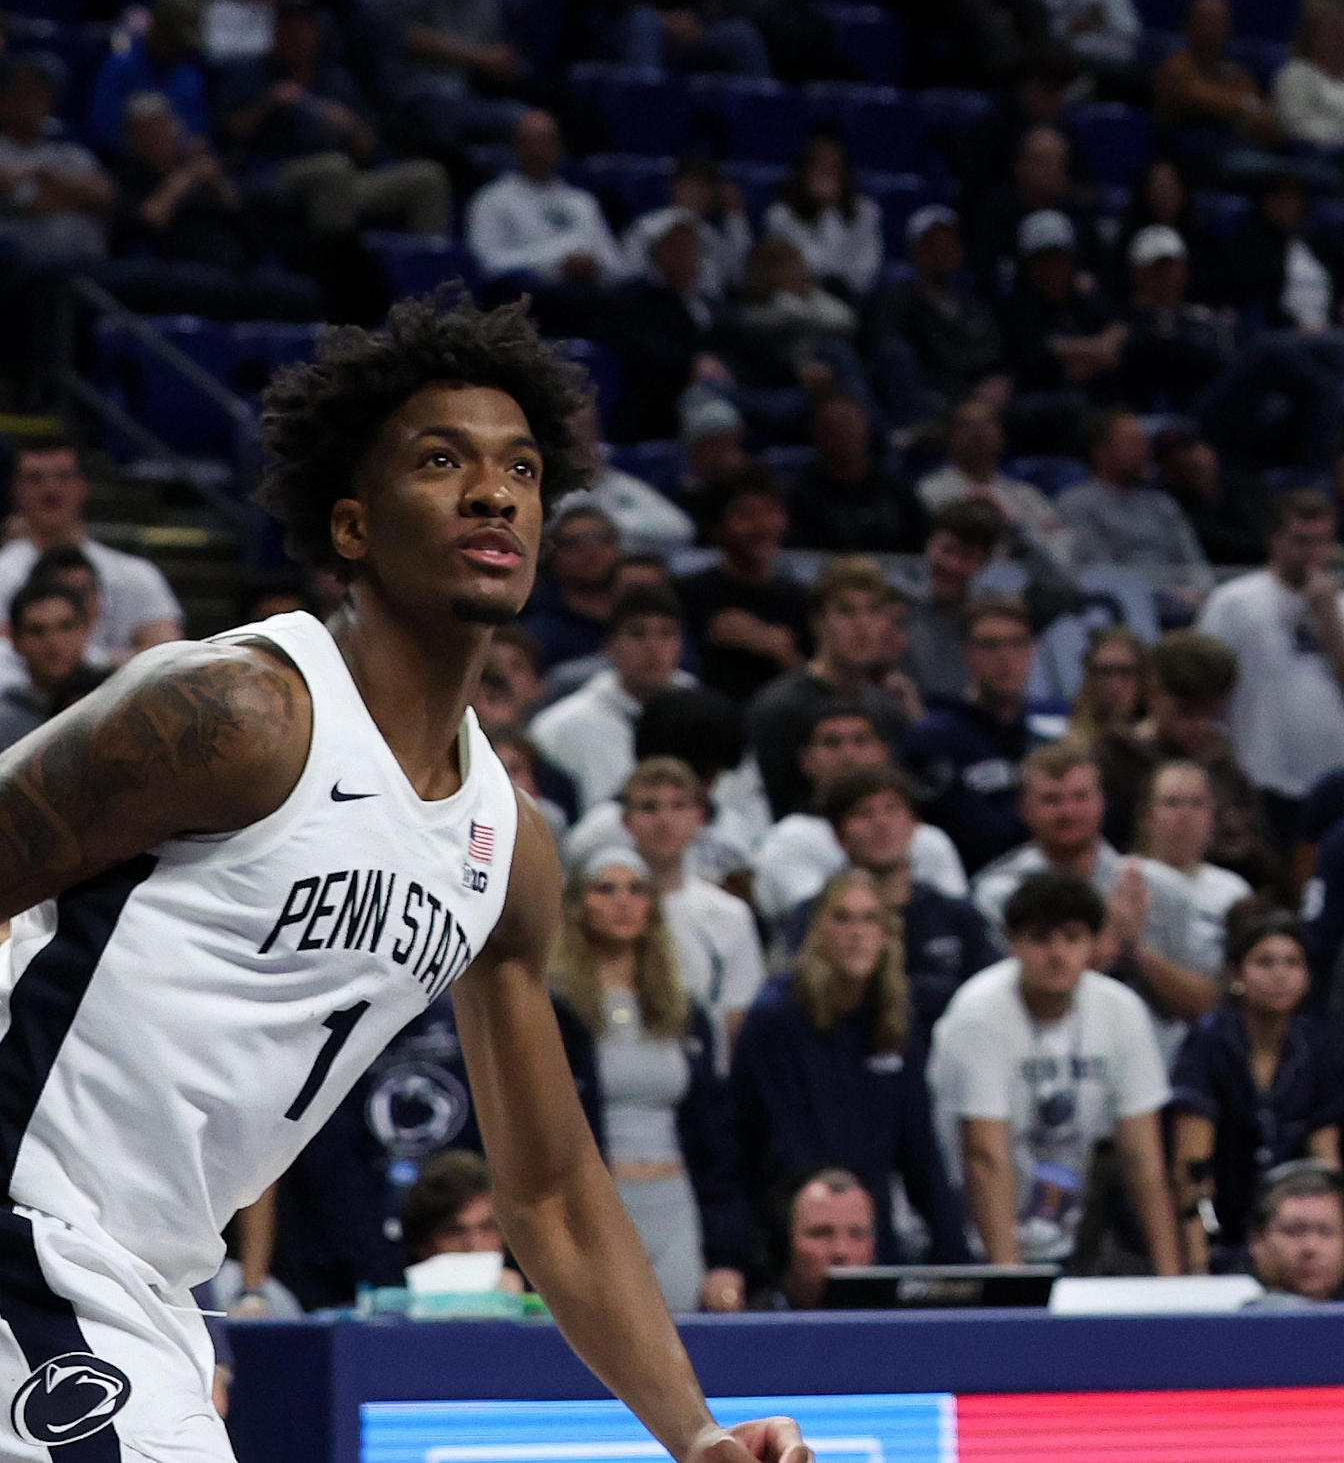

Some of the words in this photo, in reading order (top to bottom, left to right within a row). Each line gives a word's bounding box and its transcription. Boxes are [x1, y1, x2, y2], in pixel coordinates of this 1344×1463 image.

[258, 869, 396, 955] PENN
[392, 880, 472, 1005] STAT
[284, 1000, 372, 1122] 1
